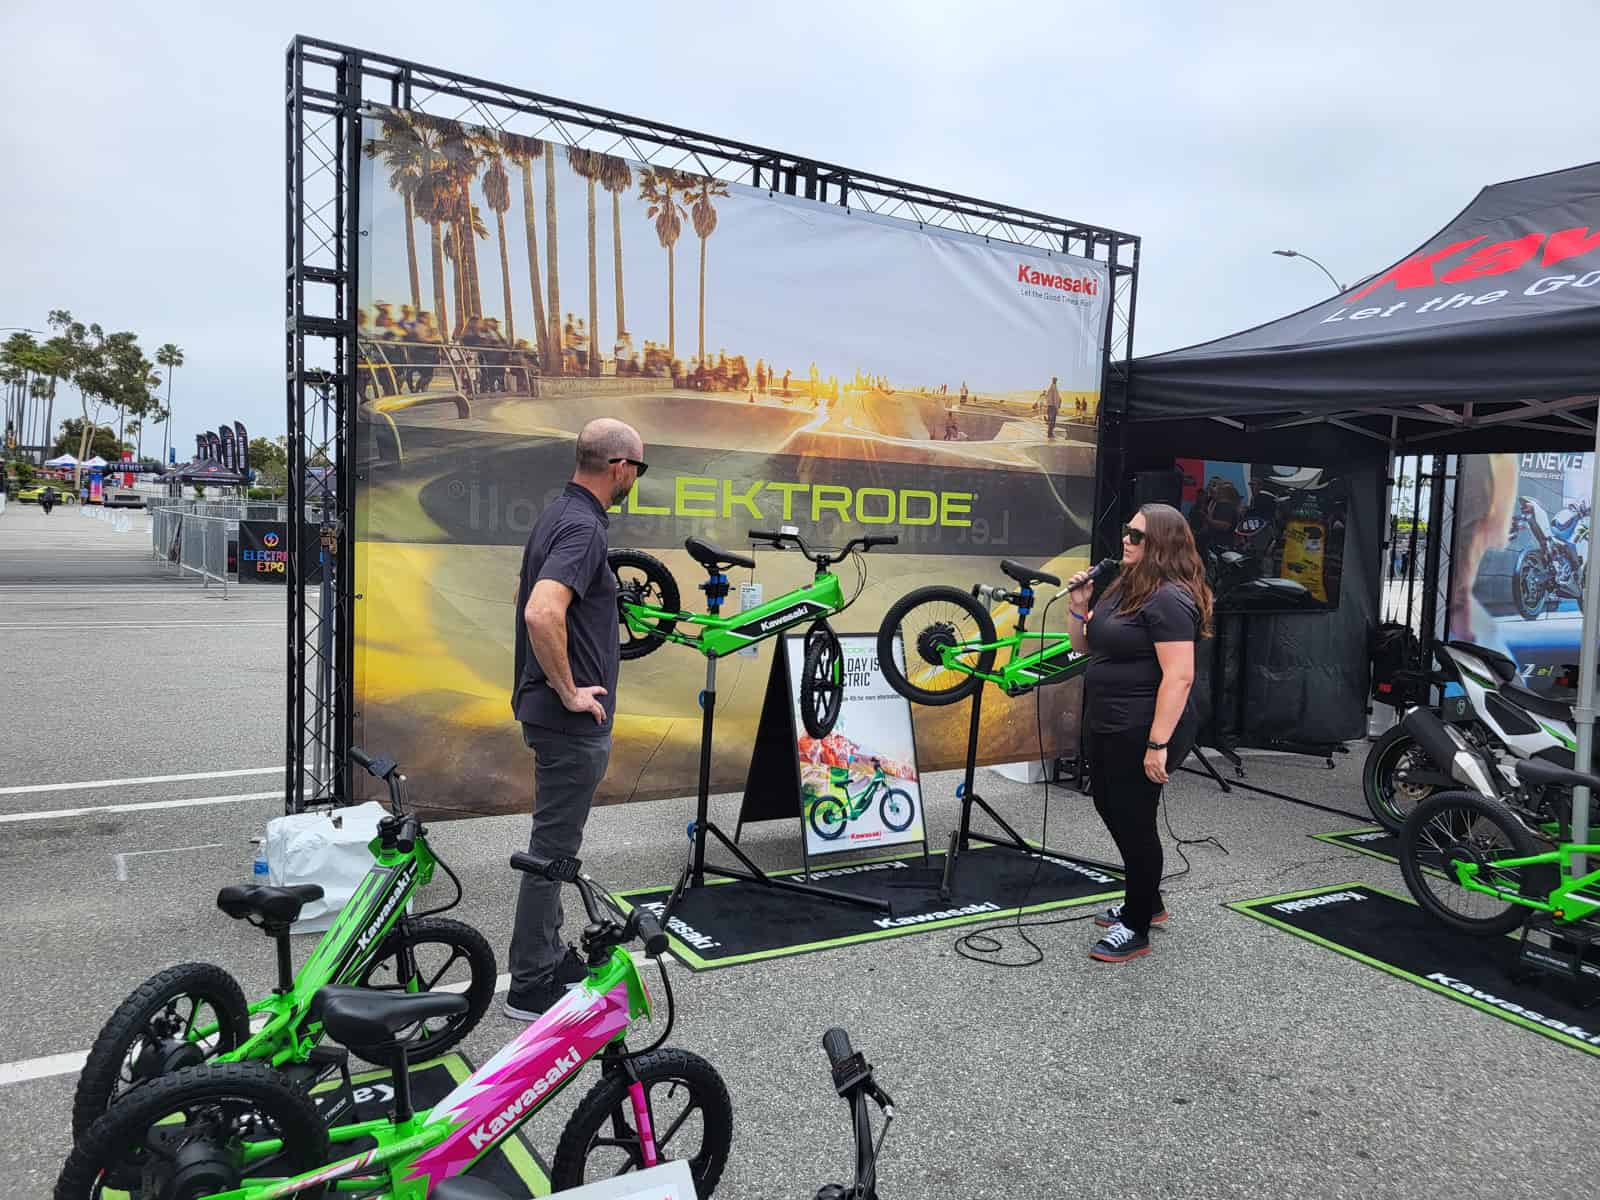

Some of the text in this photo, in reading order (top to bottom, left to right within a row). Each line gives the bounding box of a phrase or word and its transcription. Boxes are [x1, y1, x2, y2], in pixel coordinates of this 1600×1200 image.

[1017, 264, 1098, 297] Kawasaki
[1320, 300, 1408, 324] Let
[1416, 290, 1509, 314] the
[607, 476, 972, 528] LEKTRODE
[257, 562, 285, 573] EXPO
[761, 605, 808, 632] Kawasaki
[847, 657, 868, 673] DAY
[357, 871, 410, 951] Kawasaki
[873, 901, 1000, 929] Kawasaki
[1271, 891, 1368, 914] Kawasaki
[467, 1045, 584, 1151] Kawasaki
